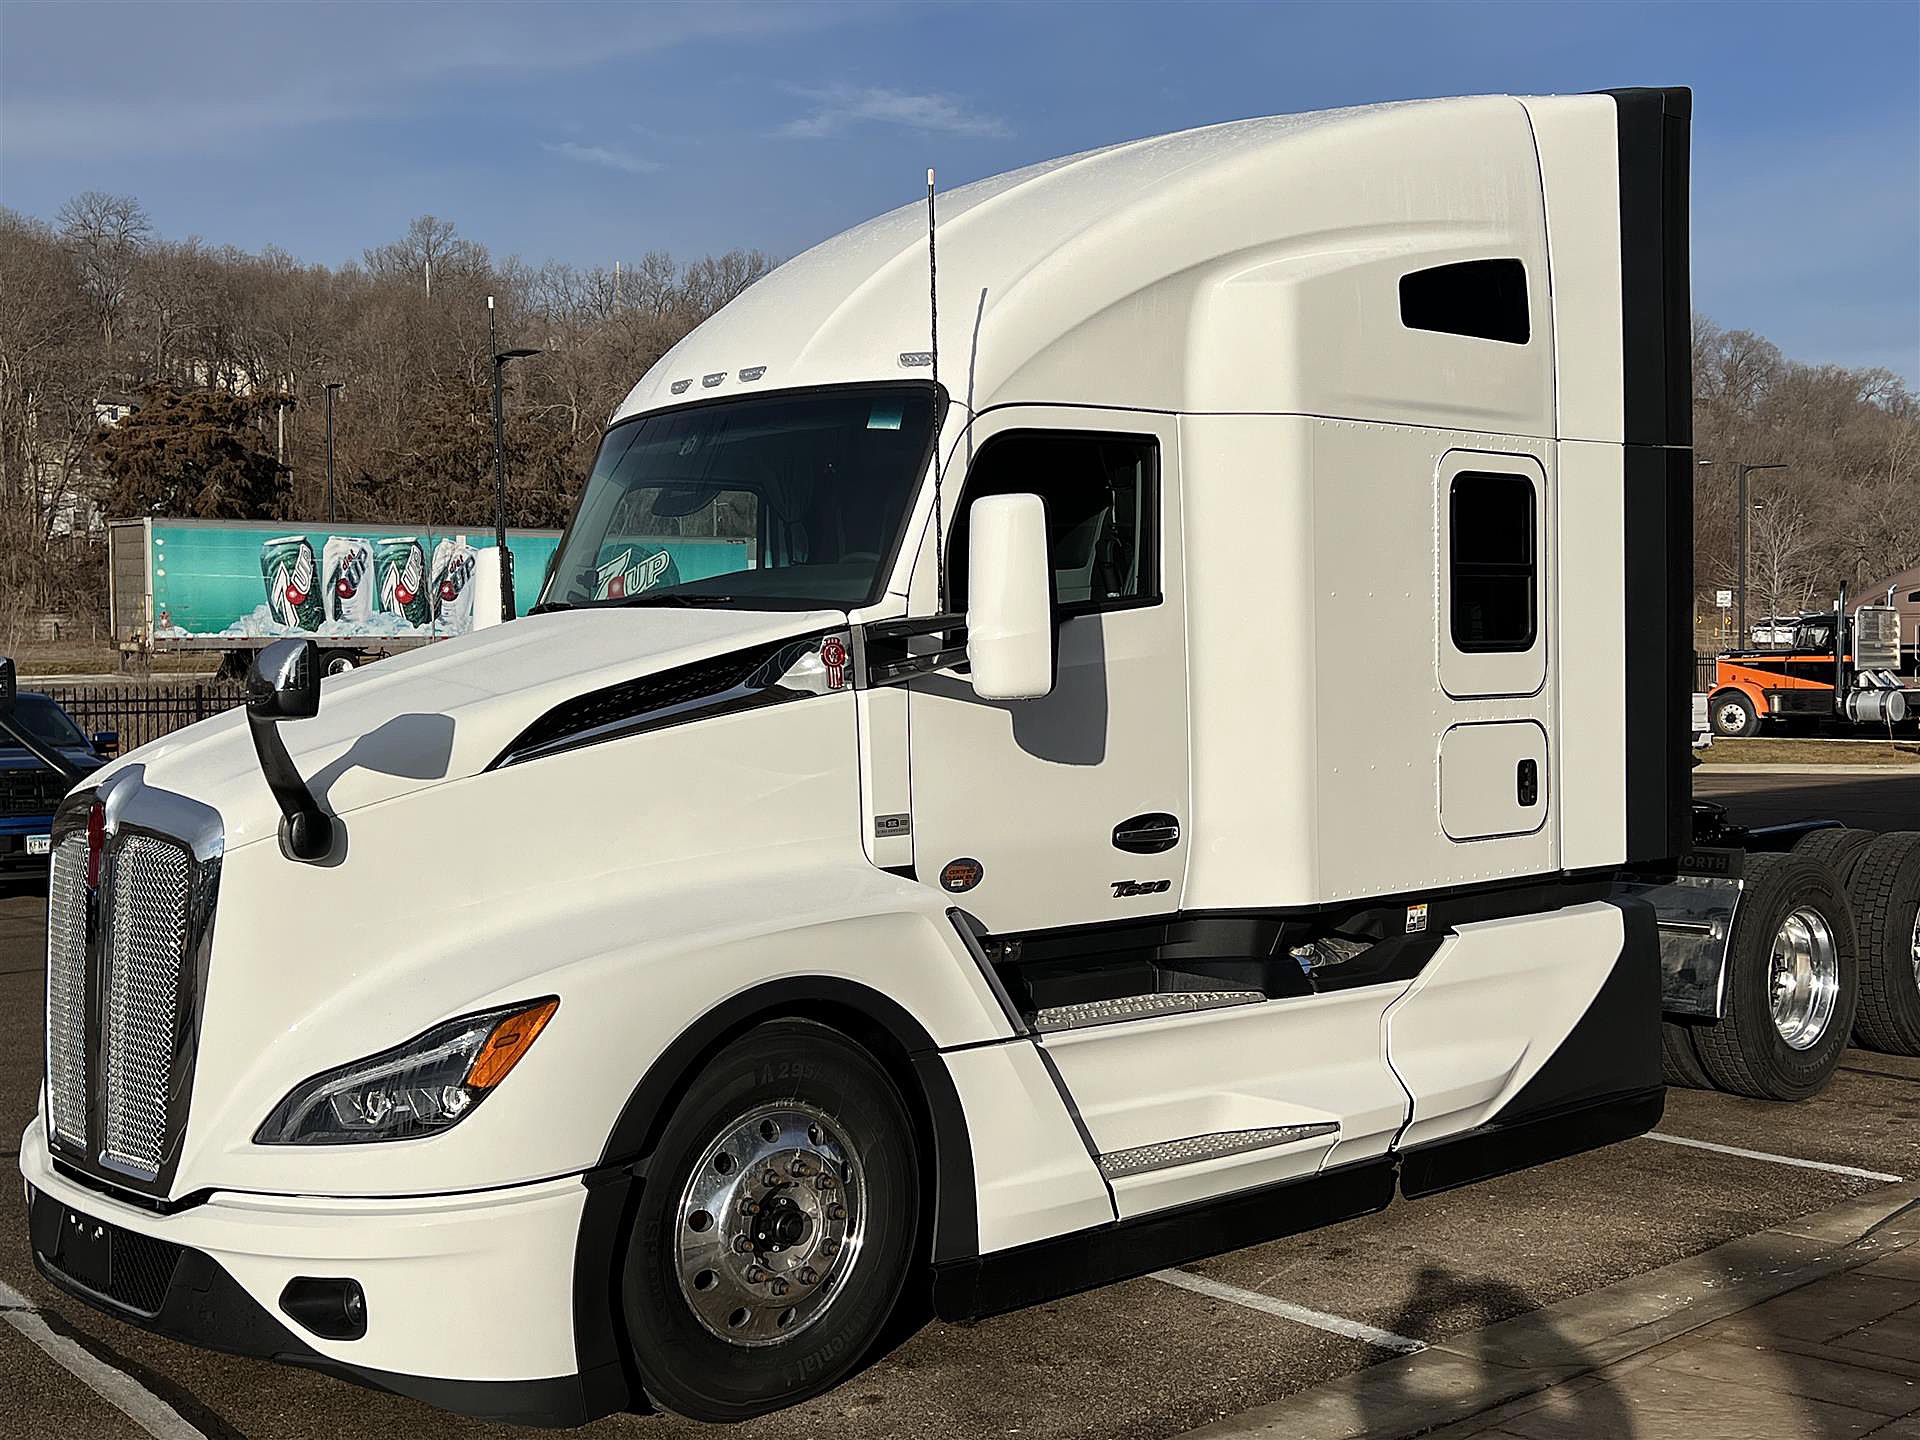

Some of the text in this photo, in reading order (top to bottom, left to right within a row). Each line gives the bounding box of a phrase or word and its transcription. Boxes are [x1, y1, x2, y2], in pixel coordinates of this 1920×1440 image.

[342, 549, 356, 571] diet
[449, 554, 464, 573] diet
[594, 548, 670, 601] 7UP
[1111, 880, 1171, 898] T680
